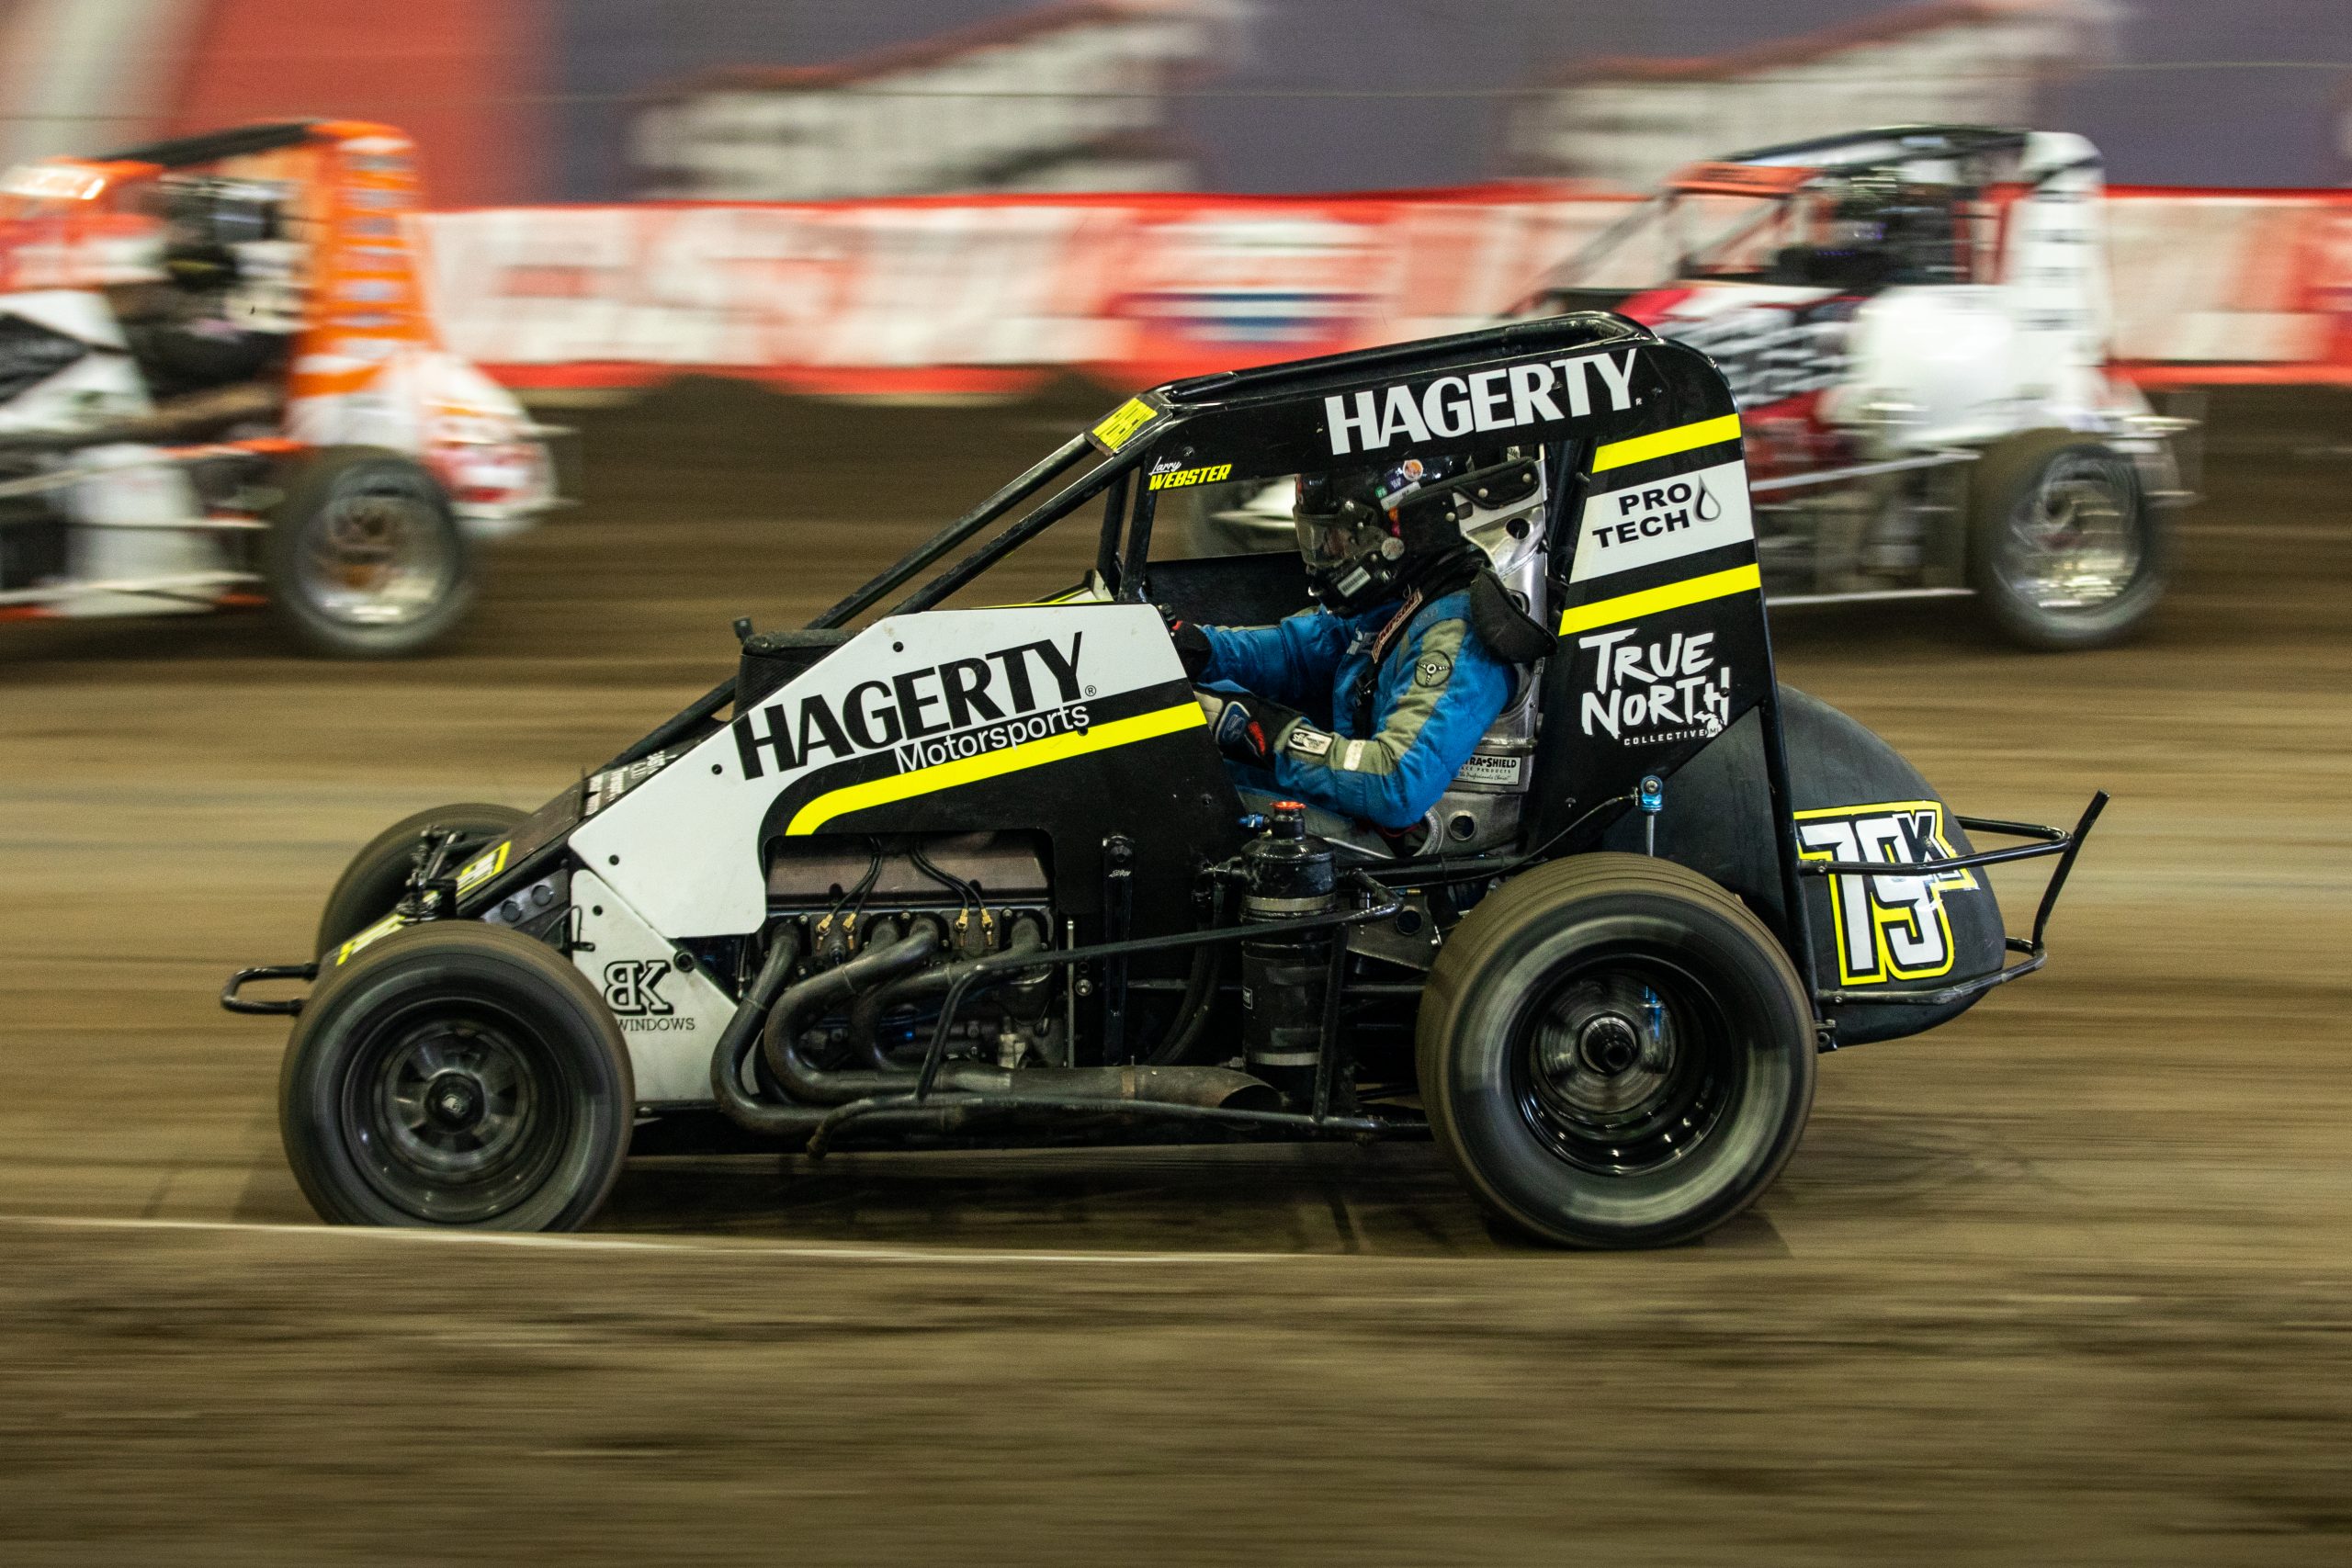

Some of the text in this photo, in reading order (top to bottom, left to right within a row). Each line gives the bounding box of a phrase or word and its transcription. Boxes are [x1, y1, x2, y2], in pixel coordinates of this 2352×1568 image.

[1325, 348, 1637, 456] HAGERTY
[1148, 456, 1182, 476] Larry
[1148, 464, 1232, 491] WEBSTER
[1619, 483, 1692, 516] PRO
[1592, 509, 1690, 548] TECH
[1578, 627, 1714, 695] TRUE
[732, 631, 1084, 782] HAGERTY
[1581, 666, 1730, 740] NORTH
[893, 703, 1091, 775] Motorsports
[1623, 728, 1706, 747] COLLECTIVE
